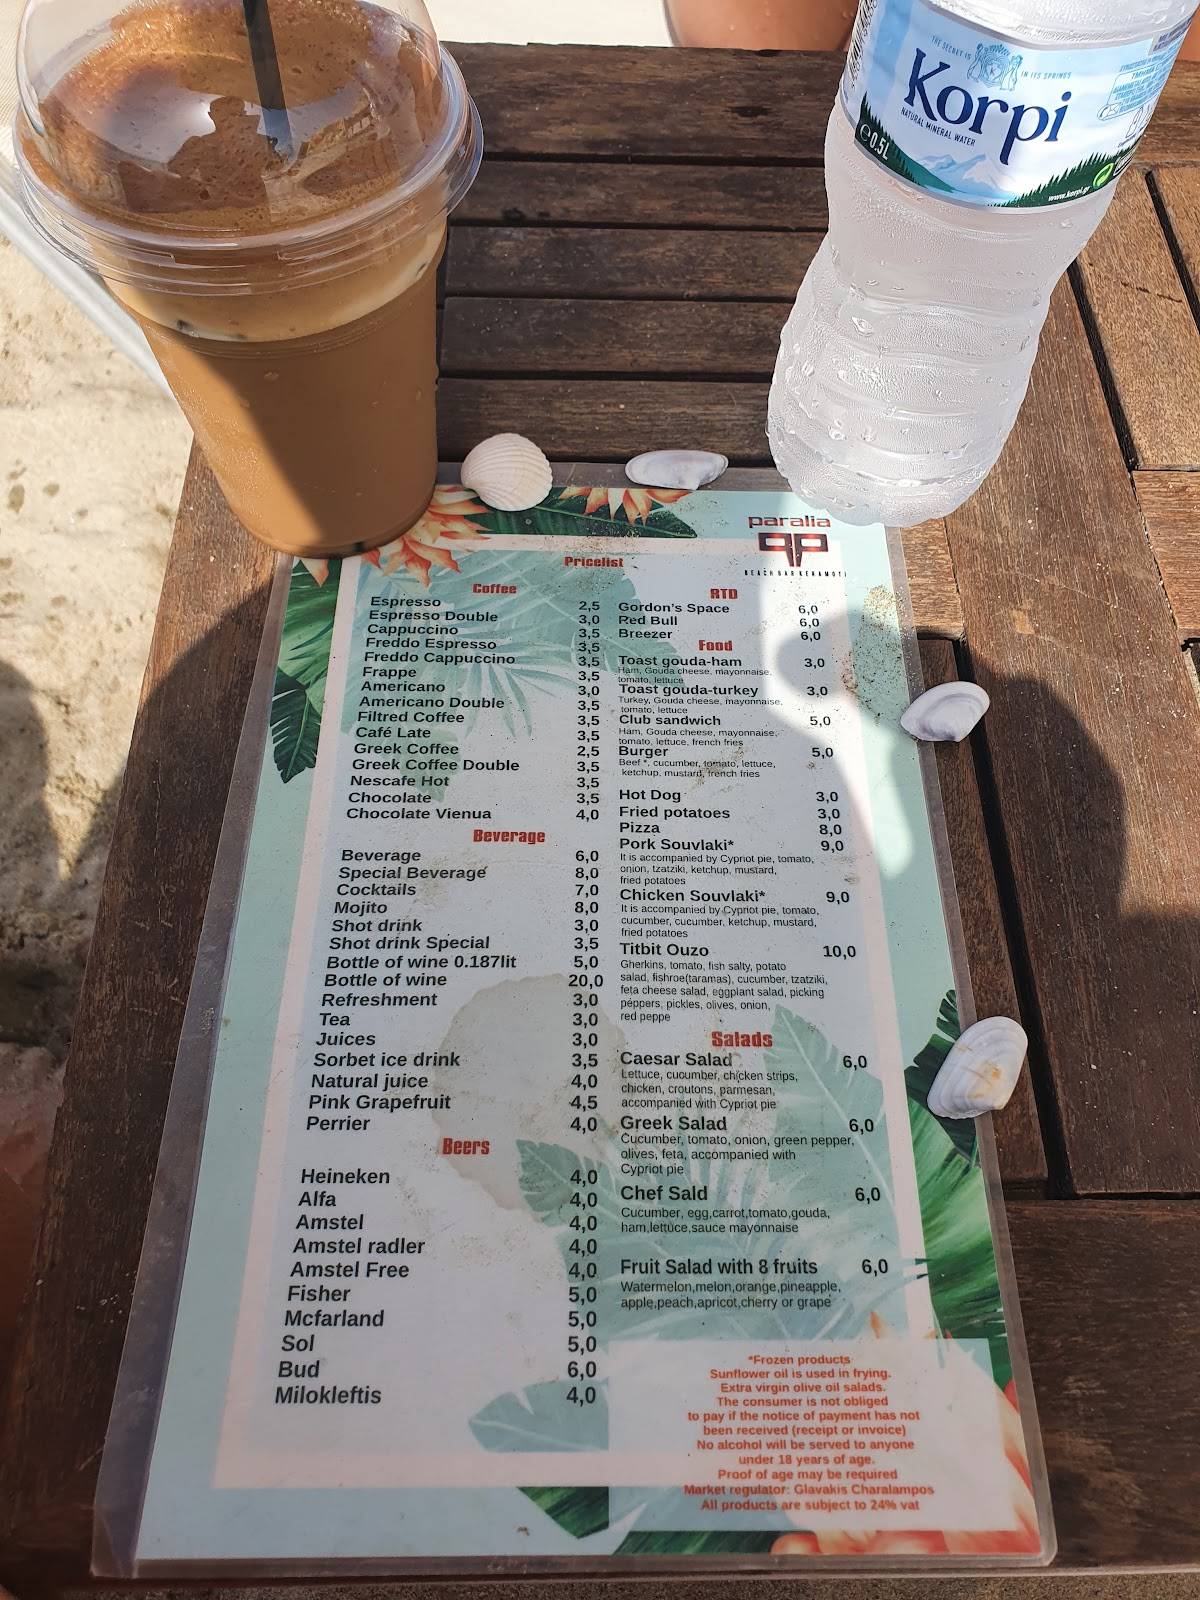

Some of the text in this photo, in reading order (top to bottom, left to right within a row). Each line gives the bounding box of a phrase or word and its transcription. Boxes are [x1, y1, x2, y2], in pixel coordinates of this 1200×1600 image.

[904, 48, 1072, 166] Korpi
[901, 107, 976, 146] NATURAL MINERAL WATER
[1048, 186, 1091, 201] www.korpi.gr
[748, 516, 831, 528] paralia
[564, 557, 624, 568] Pricelist
[473, 584, 516, 594] Coffee
[710, 588, 737, 599] RTD
[371, 596, 441, 608] Espresso
[687, 603, 729, 615] Space
[799, 605, 818, 615] 6,0
[369, 610, 498, 622] Espresso Double
[619, 616, 677, 626] Red Bull
[368, 624, 458, 636] Cappuccino
[619, 629, 672, 639] Breezer
[366, 638, 496, 650] Freddo Espresso
[699, 640, 732, 651] Food
[364, 652, 515, 665] Freddo Cappuccino
[619, 656, 742, 668] Toast gouda-ham
[362, 667, 416, 679] Frappe
[361, 681, 445, 692] Americano
[619, 684, 758, 697] Toast gouda-turkey
[359, 697, 504, 708] Americano Double
[357, 712, 464, 723] Filtred Coffee
[619, 715, 721, 726] Club sandwich
[810, 716, 831, 727] 5,0
[356, 727, 431, 738] Café Late
[619, 746, 668, 758] Burger
[352, 759, 519, 771] Greek Coffee Double
[350, 776, 449, 787] Nescafe Hot
[349, 792, 431, 803] Chocolate
[619, 790, 681, 803] Hot Dog
[347, 808, 491, 819] Chocolate Vienua
[576, 809, 599, 821] 4,0
[620, 806, 730, 820] Fried potatoes
[620, 822, 660, 833] Pizza
[473, 830, 545, 844] Beverage
[620, 839, 655, 849] Pork
[342, 850, 421, 862] Beverage
[339, 867, 486, 880] Special Beverage
[735, 866, 777, 875] mustard,
[337, 884, 416, 896] Cocktails
[620, 889, 684, 901] Chicken
[826, 891, 849, 903] 9,0
[334, 902, 387, 916] Mojito
[330, 936, 490, 952] Shot drink Special
[620, 943, 709, 956] Titbit Ouzo
[823, 945, 856, 959] 10,0
[327, 956, 516, 968] Bottle of wine 0.187lit
[568, 974, 603, 988] 20,0
[322, 993, 437, 1007] Refreshment
[320, 1013, 350, 1026] Tea
[621, 1012, 670, 1023] red peppe
[316, 1032, 376, 1046] Juices
[712, 1031, 772, 1047] Salads
[314, 1052, 460, 1067] Sorbet ice drink
[621, 1052, 733, 1067] Caesar Salad
[843, 1055, 867, 1071] 6,0
[312, 1074, 428, 1092] Natural juice
[309, 1094, 451, 1113] Pink Grapefruit
[306, 1116, 370, 1131] Perrier
[621, 1116, 726, 1130] Greek Salad
[443, 1138, 489, 1155] Beers
[662, 1149, 687, 1160] feta,
[691, 1149, 768, 1162] accompanied
[773, 1150, 795, 1160] with
[301, 1168, 390, 1184] Heineken
[299, 1191, 336, 1207] Alfa
[621, 1186, 708, 1201] Chef Sald
[296, 1214, 363, 1230] Amstel
[729, 1223, 798, 1235] mayonnaise
[293, 1238, 425, 1253] Amstel radler
[290, 1261, 409, 1277] Amstel Free
[620, 1259, 817, 1274] Fruit Salad with 8 fruits
[288, 1285, 350, 1301] Fisher
[285, 1310, 384, 1327] Mcfarland
[282, 1335, 314, 1352] Sol
[278, 1360, 320, 1378] Bud
[721, 1383, 886, 1394] Extra virgin olive oil salads.
[275, 1386, 381, 1404] Milokleftis
[567, 1387, 596, 1406] 4,0
[704, 1425, 906, 1437] been received (receipt or invoice)
[684, 1485, 934, 1497] Market regulator: Glavakis Charalampos
